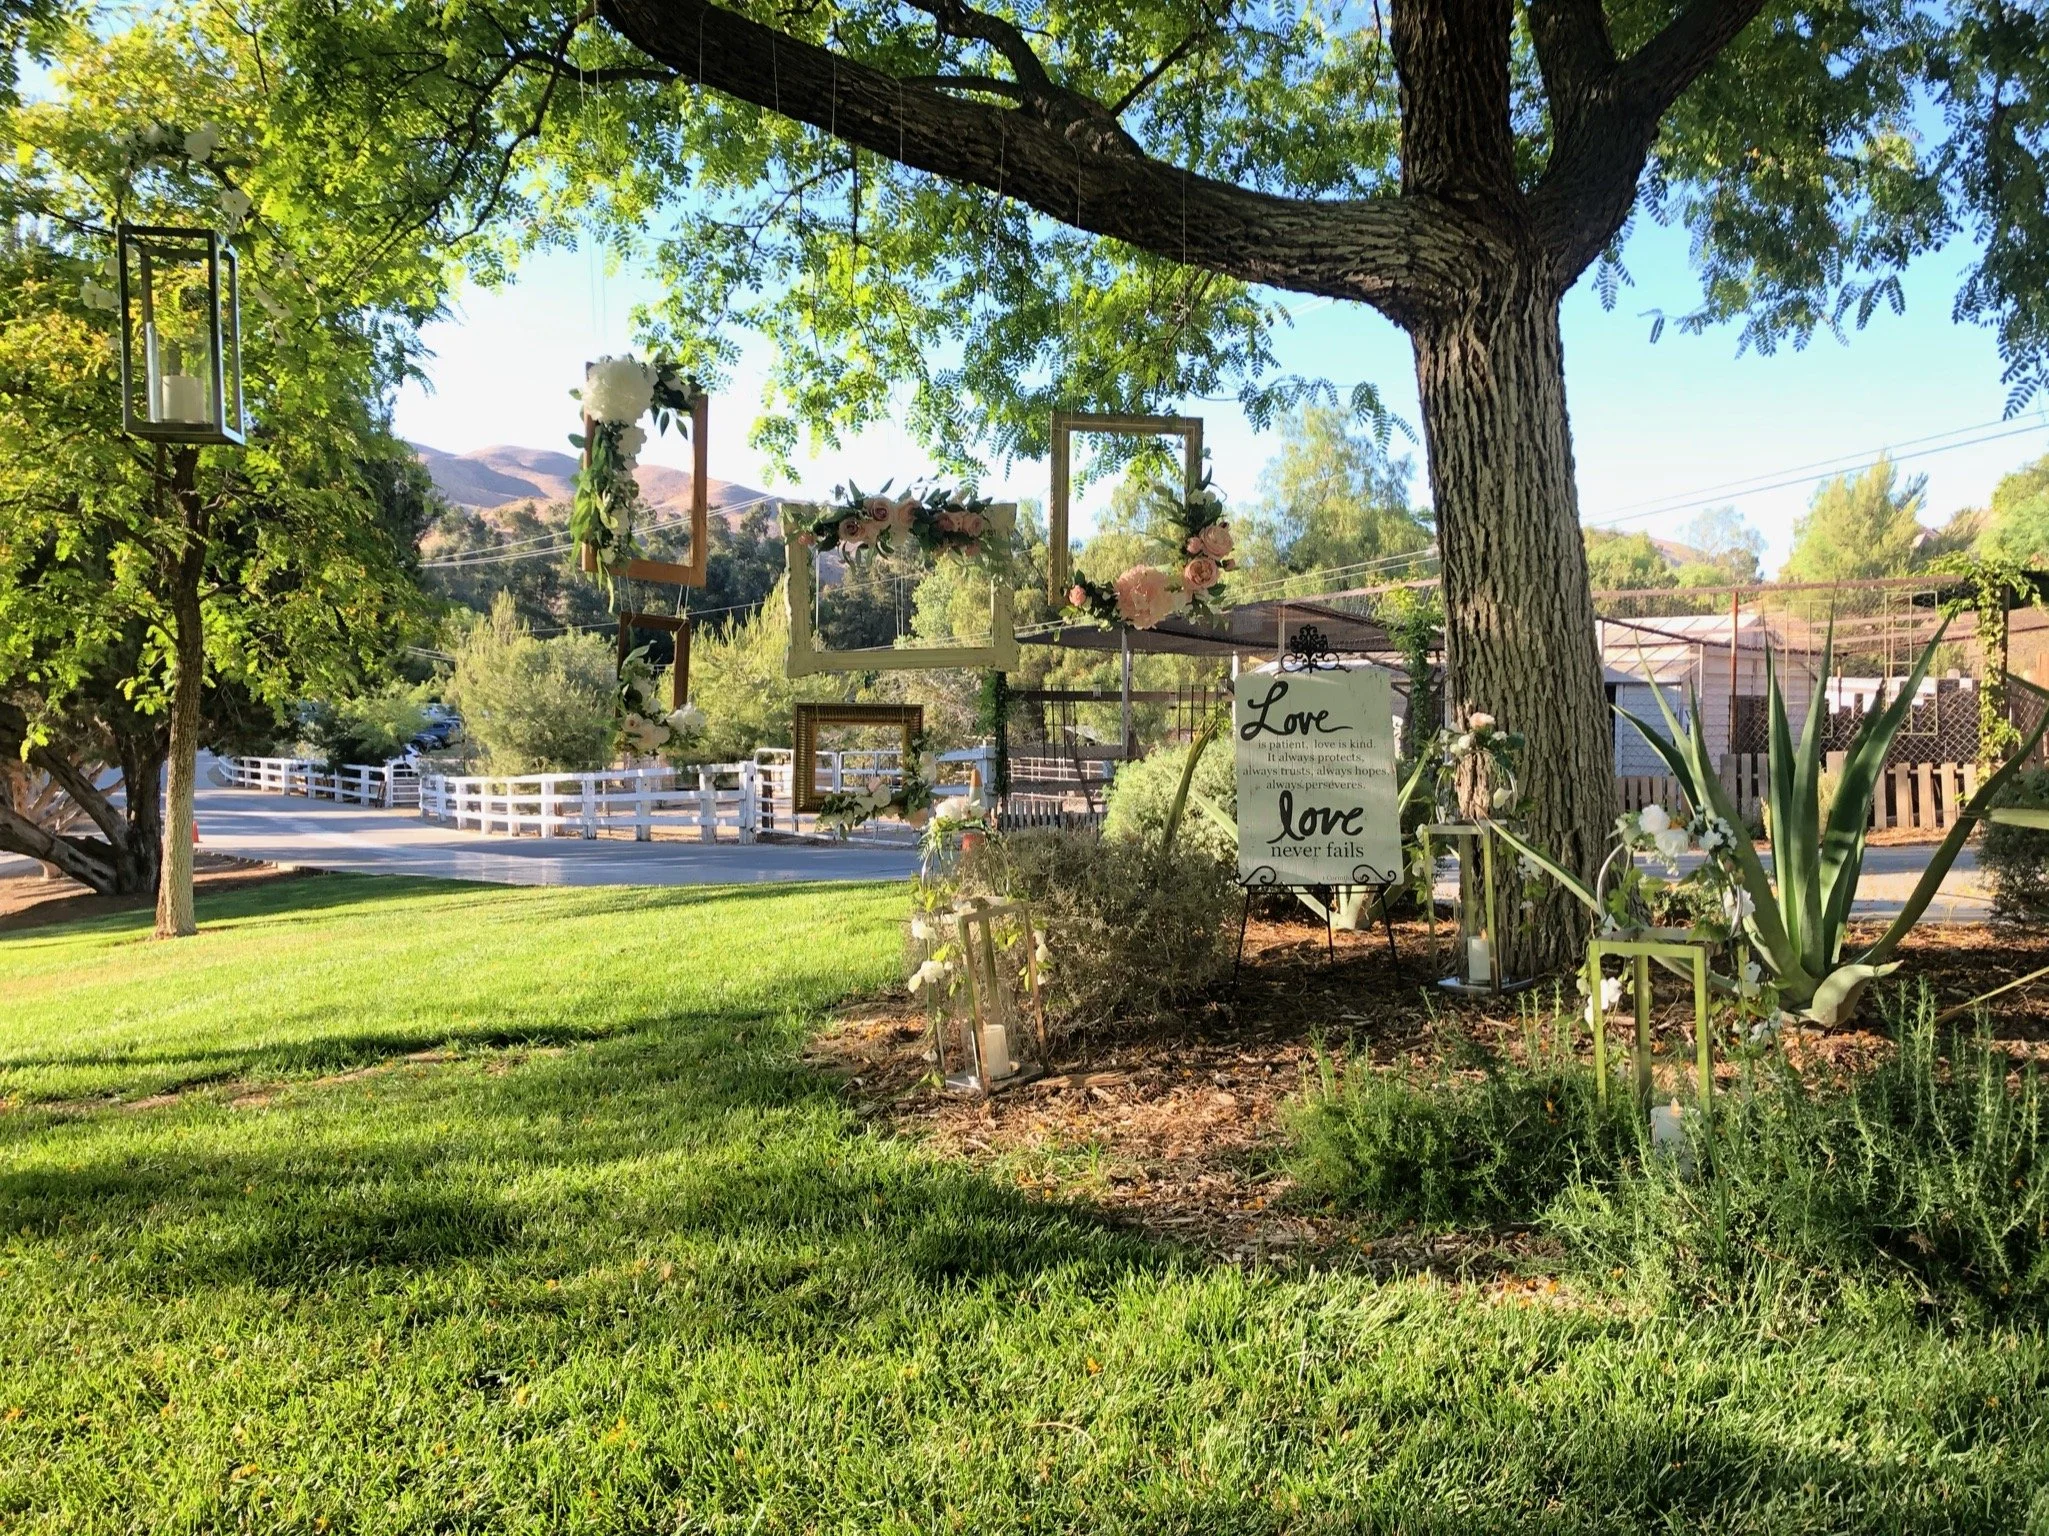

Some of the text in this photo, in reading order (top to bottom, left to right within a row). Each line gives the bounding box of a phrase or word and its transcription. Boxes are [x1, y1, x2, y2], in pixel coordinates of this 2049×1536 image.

[1240, 680, 1353, 741] Love
[1258, 738, 1376, 751] is patient, love is kind.
[1267, 752, 1365, 766] It always protects,
[1242, 765, 1278, 778] always
[1280, 767, 1313, 778] trusts,
[1316, 765, 1352, 778] always
[1266, 780, 1366, 792] always perseveres.
[1266, 790, 1364, 844] love
[1271, 841, 1364, 858] never fails
